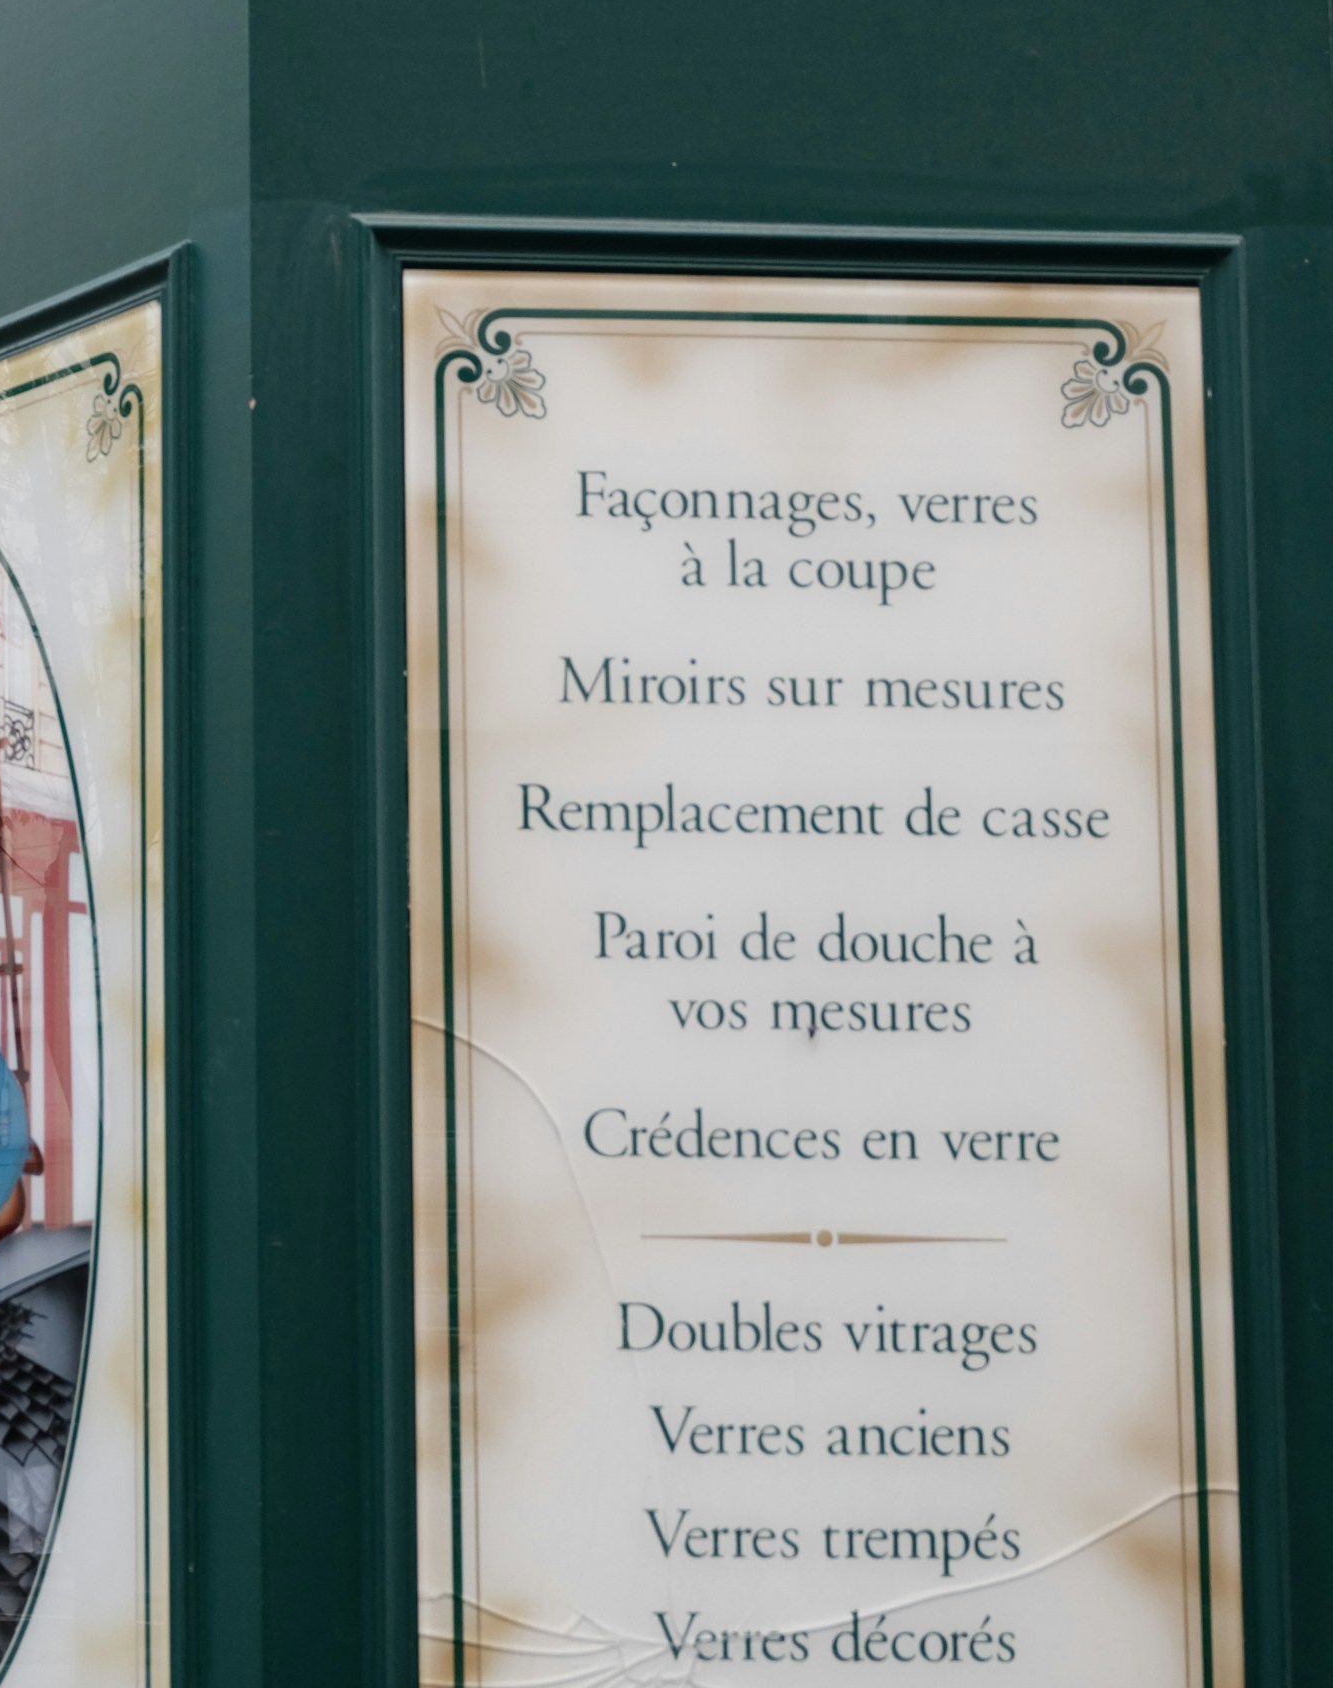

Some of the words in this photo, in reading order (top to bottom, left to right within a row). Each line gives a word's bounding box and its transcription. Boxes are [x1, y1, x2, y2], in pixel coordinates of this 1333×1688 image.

[579, 471, 875, 537] Façonnages,
[899, 495, 1037, 524] verres
[682, 542, 705, 586] à
[729, 538, 766, 587] la
[789, 560, 935, 606] coupe
[561, 657, 745, 704] Miroirs
[768, 678, 842, 706] sur
[867, 679, 1063, 710] mesures
[520, 783, 883, 848] Remplacement
[906, 787, 960, 836] de
[983, 808, 1109, 838] casse
[597, 912, 715, 959] Paroi
[741, 911, 795, 961] de
[819, 912, 991, 963] douche
[1015, 919, 1038, 964] à
[670, 1000, 747, 1029] vos
[772, 999, 971, 1033] mesures
[584, 1108, 840, 1159] Crédences
[863, 1131, 917, 1160] en
[942, 1132, 1059, 1161] verre
[620, 1301, 822, 1352] Doubles
[844, 1305, 1036, 1371] vitrages
[651, 1406, 804, 1455] Verres
[828, 1408, 1009, 1456] anciens
[646, 1509, 799, 1558] Verres
[824, 1514, 1020, 1577] trempés
[655, 1612, 809, 1661] Verres
[832, 1611, 1015, 1662] décorés
